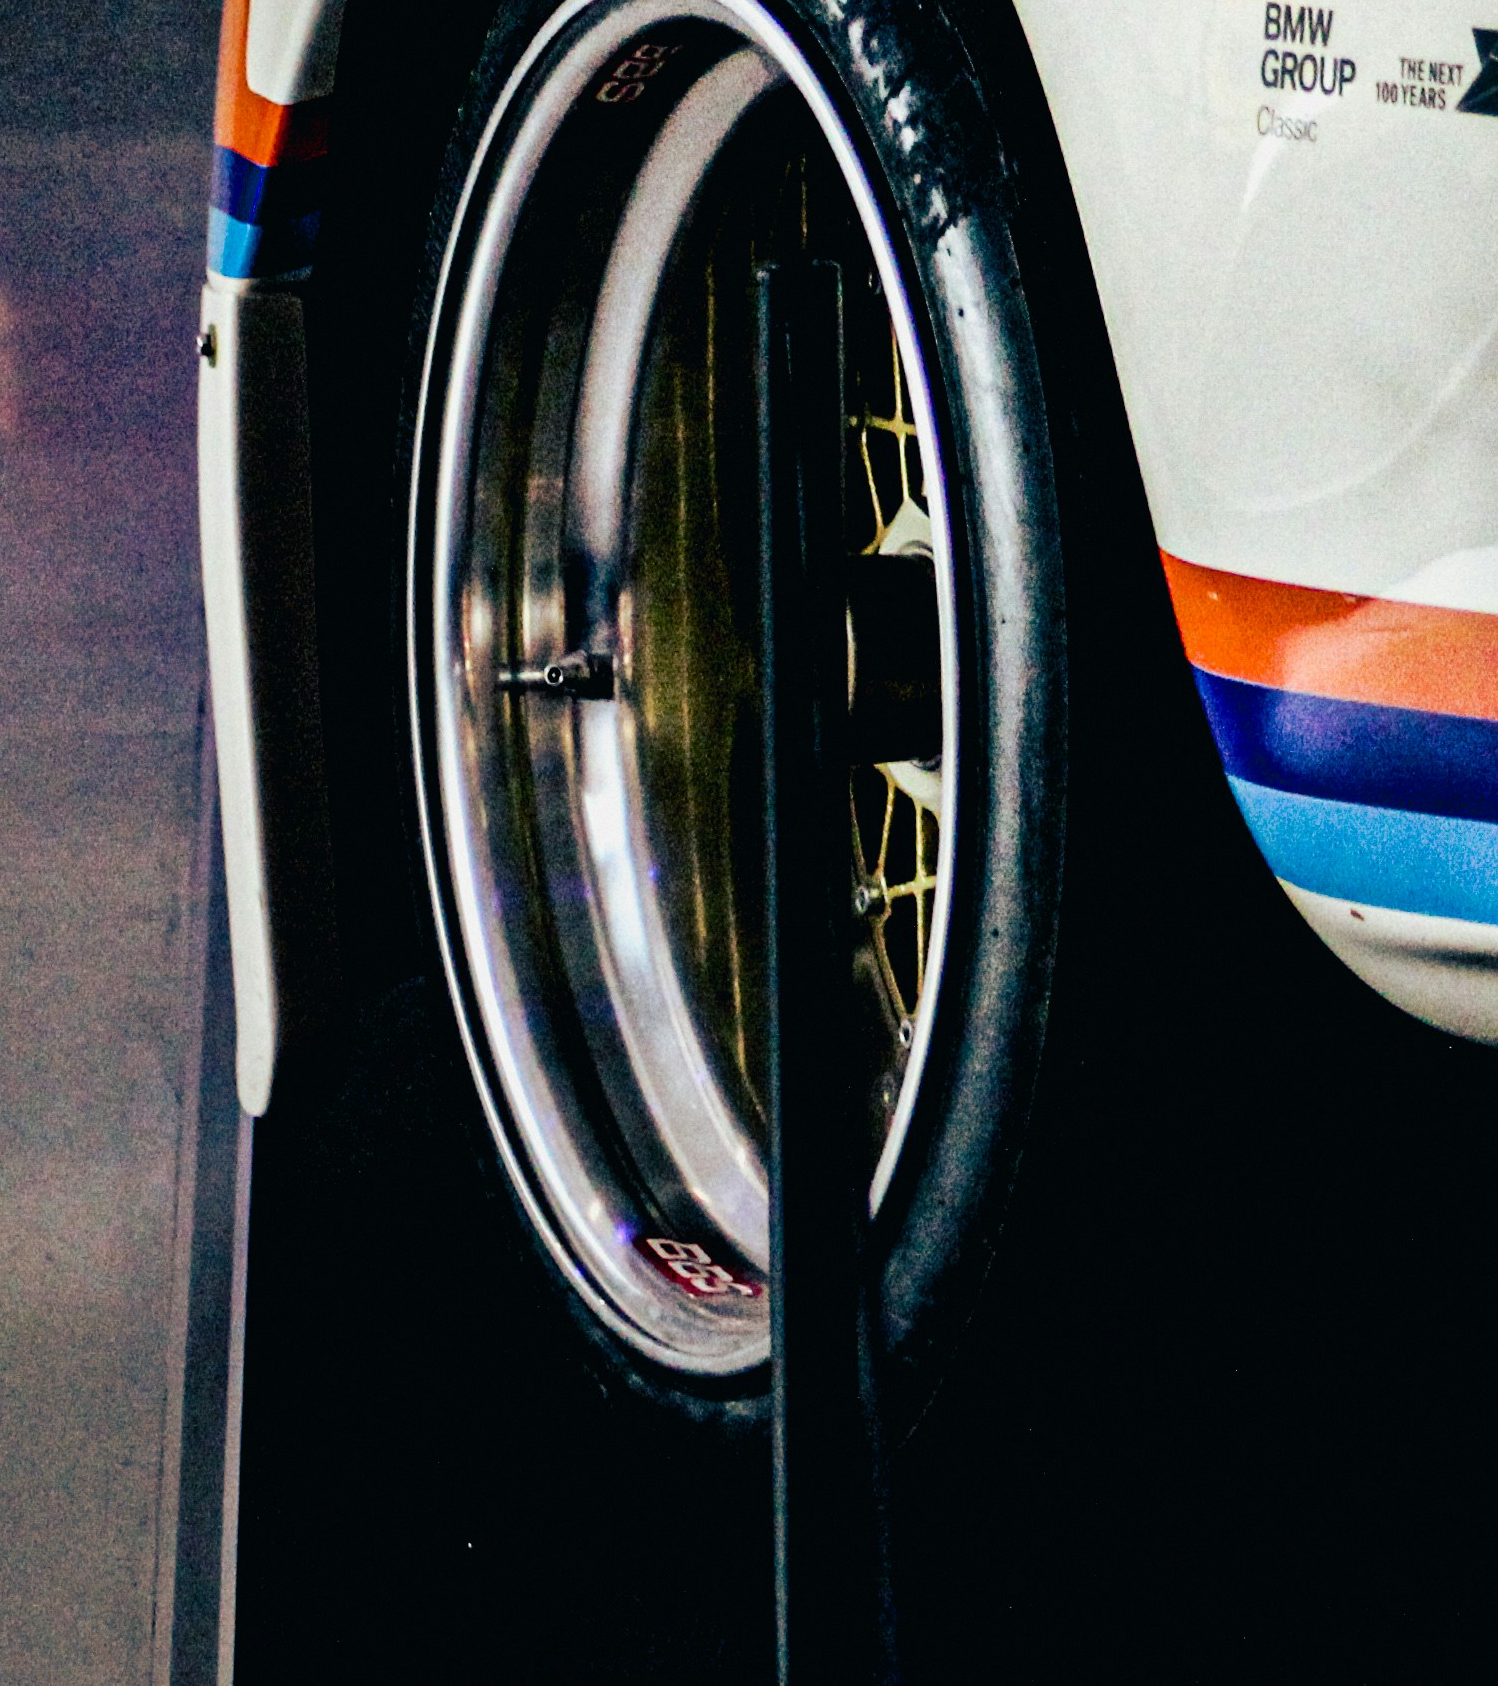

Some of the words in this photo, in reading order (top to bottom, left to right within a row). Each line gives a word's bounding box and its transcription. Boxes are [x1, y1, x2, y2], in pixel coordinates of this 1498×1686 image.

[1264, 1, 1334, 47] BMW
[1260, 48, 1357, 97] GROUP
[1399, 57, 1425, 83] THE
[1429, 61, 1464, 86] NEXT
[1375, 81, 1398, 105] 100
[1401, 84, 1446, 111] YEARS
[1256, 105, 1318, 143] Classic
